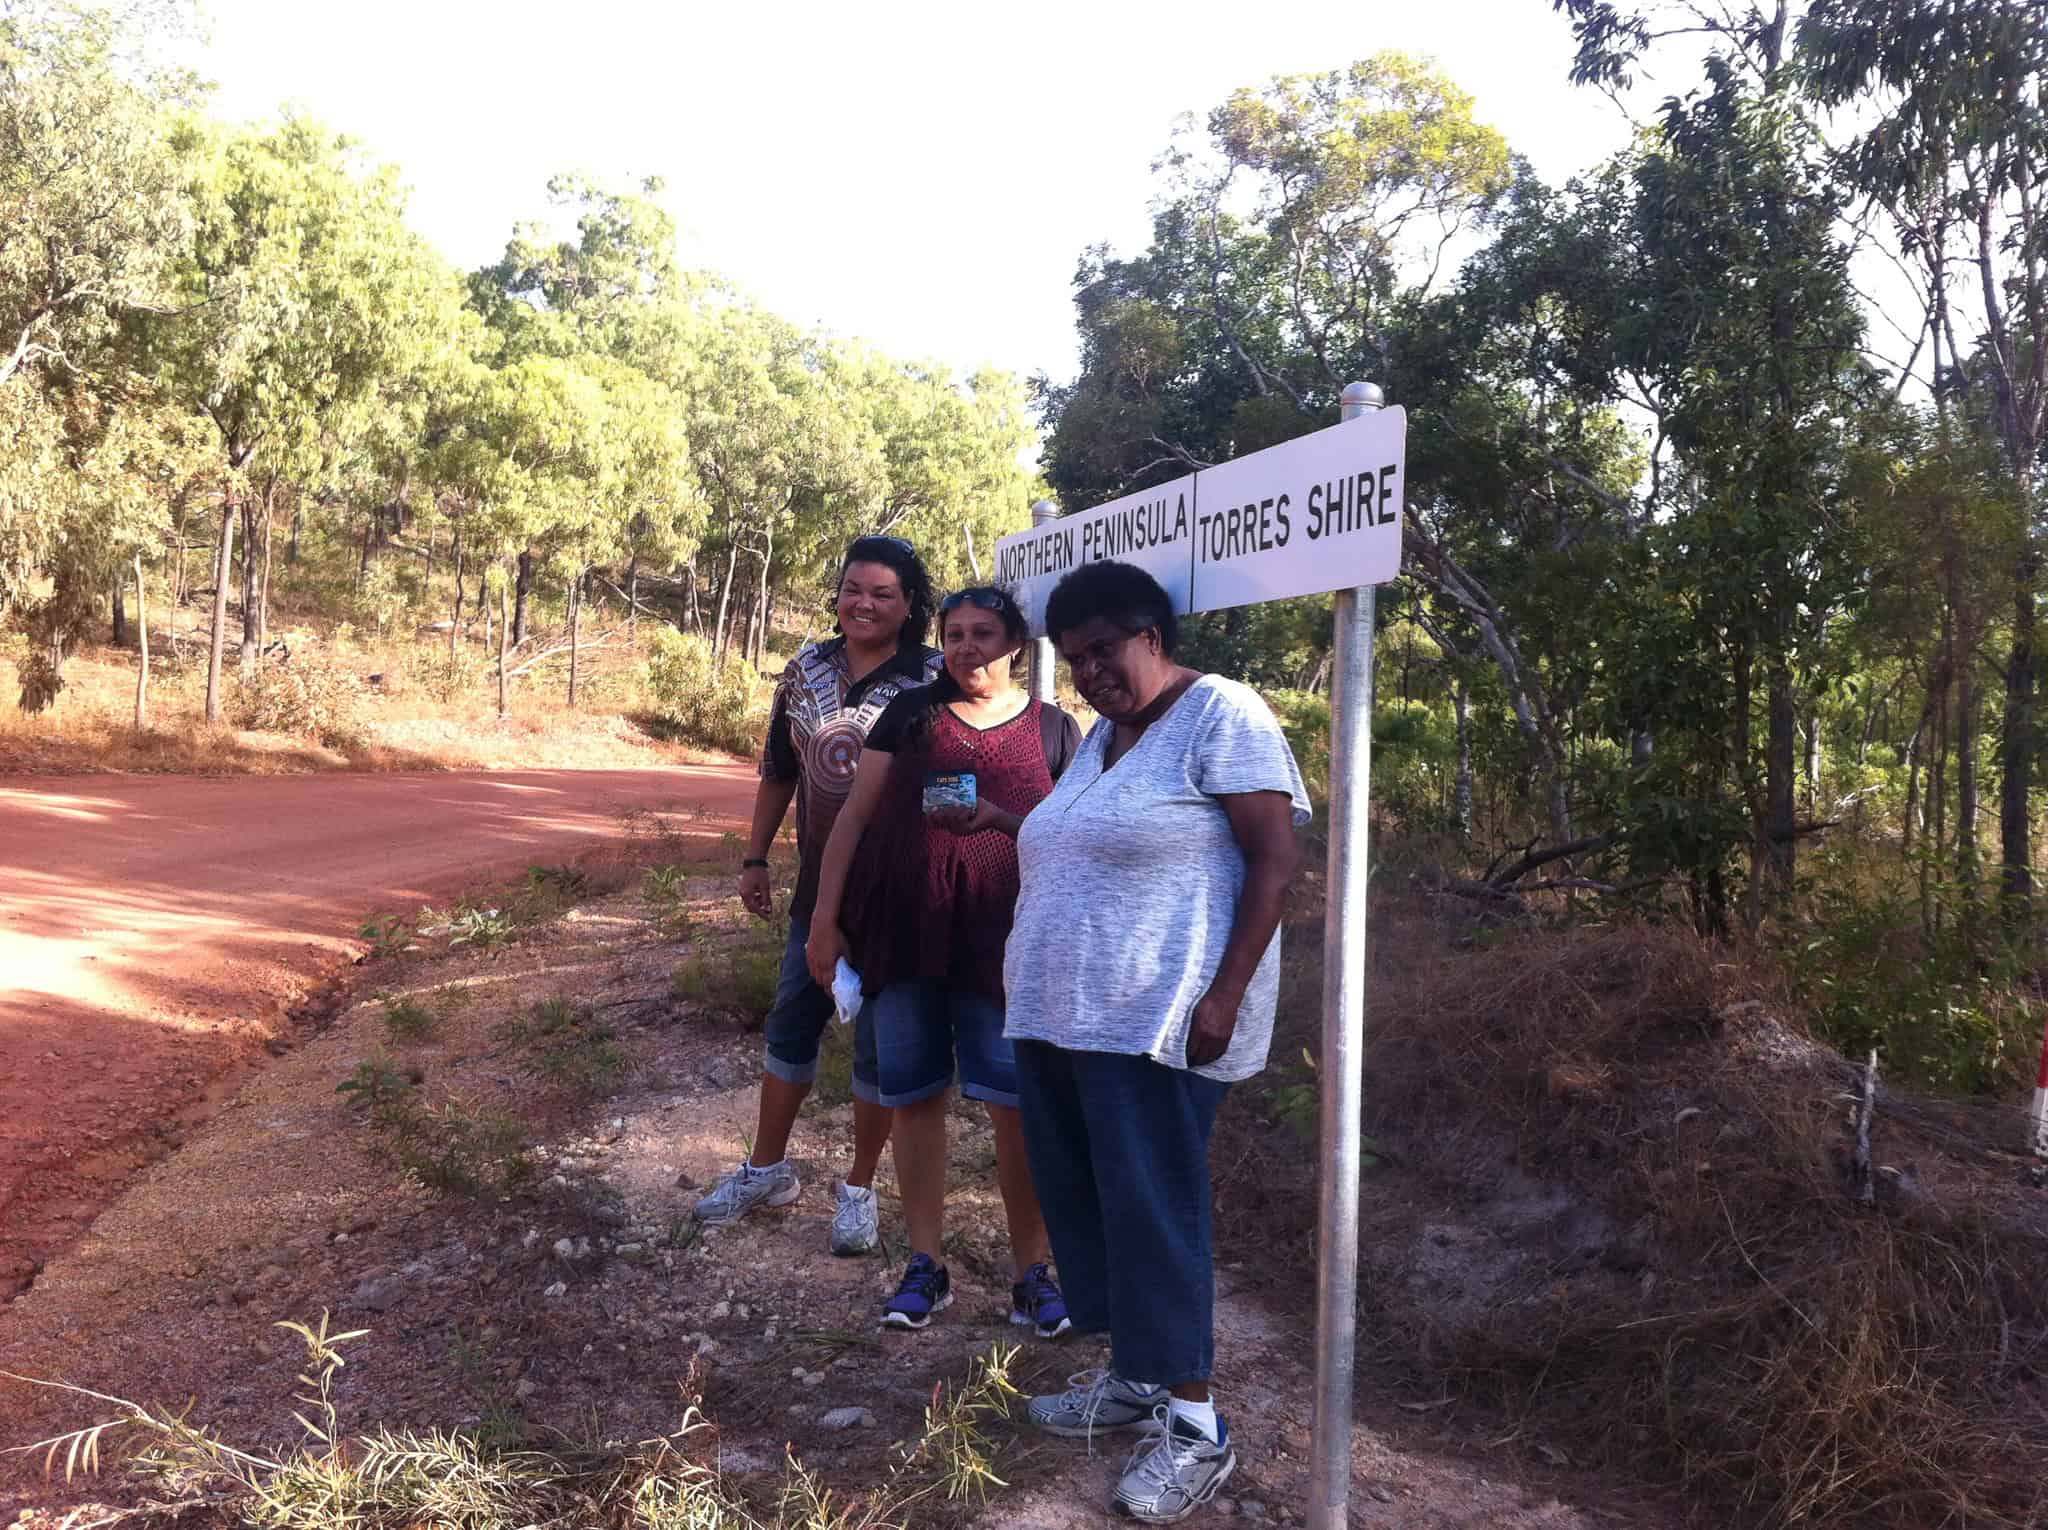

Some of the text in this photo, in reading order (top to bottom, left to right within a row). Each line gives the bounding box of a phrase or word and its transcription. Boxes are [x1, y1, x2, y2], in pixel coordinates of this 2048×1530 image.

[1000, 493, 1187, 583] NORTHERN PENINSULA
[1200, 464, 1397, 563] TORRES SHIRE
